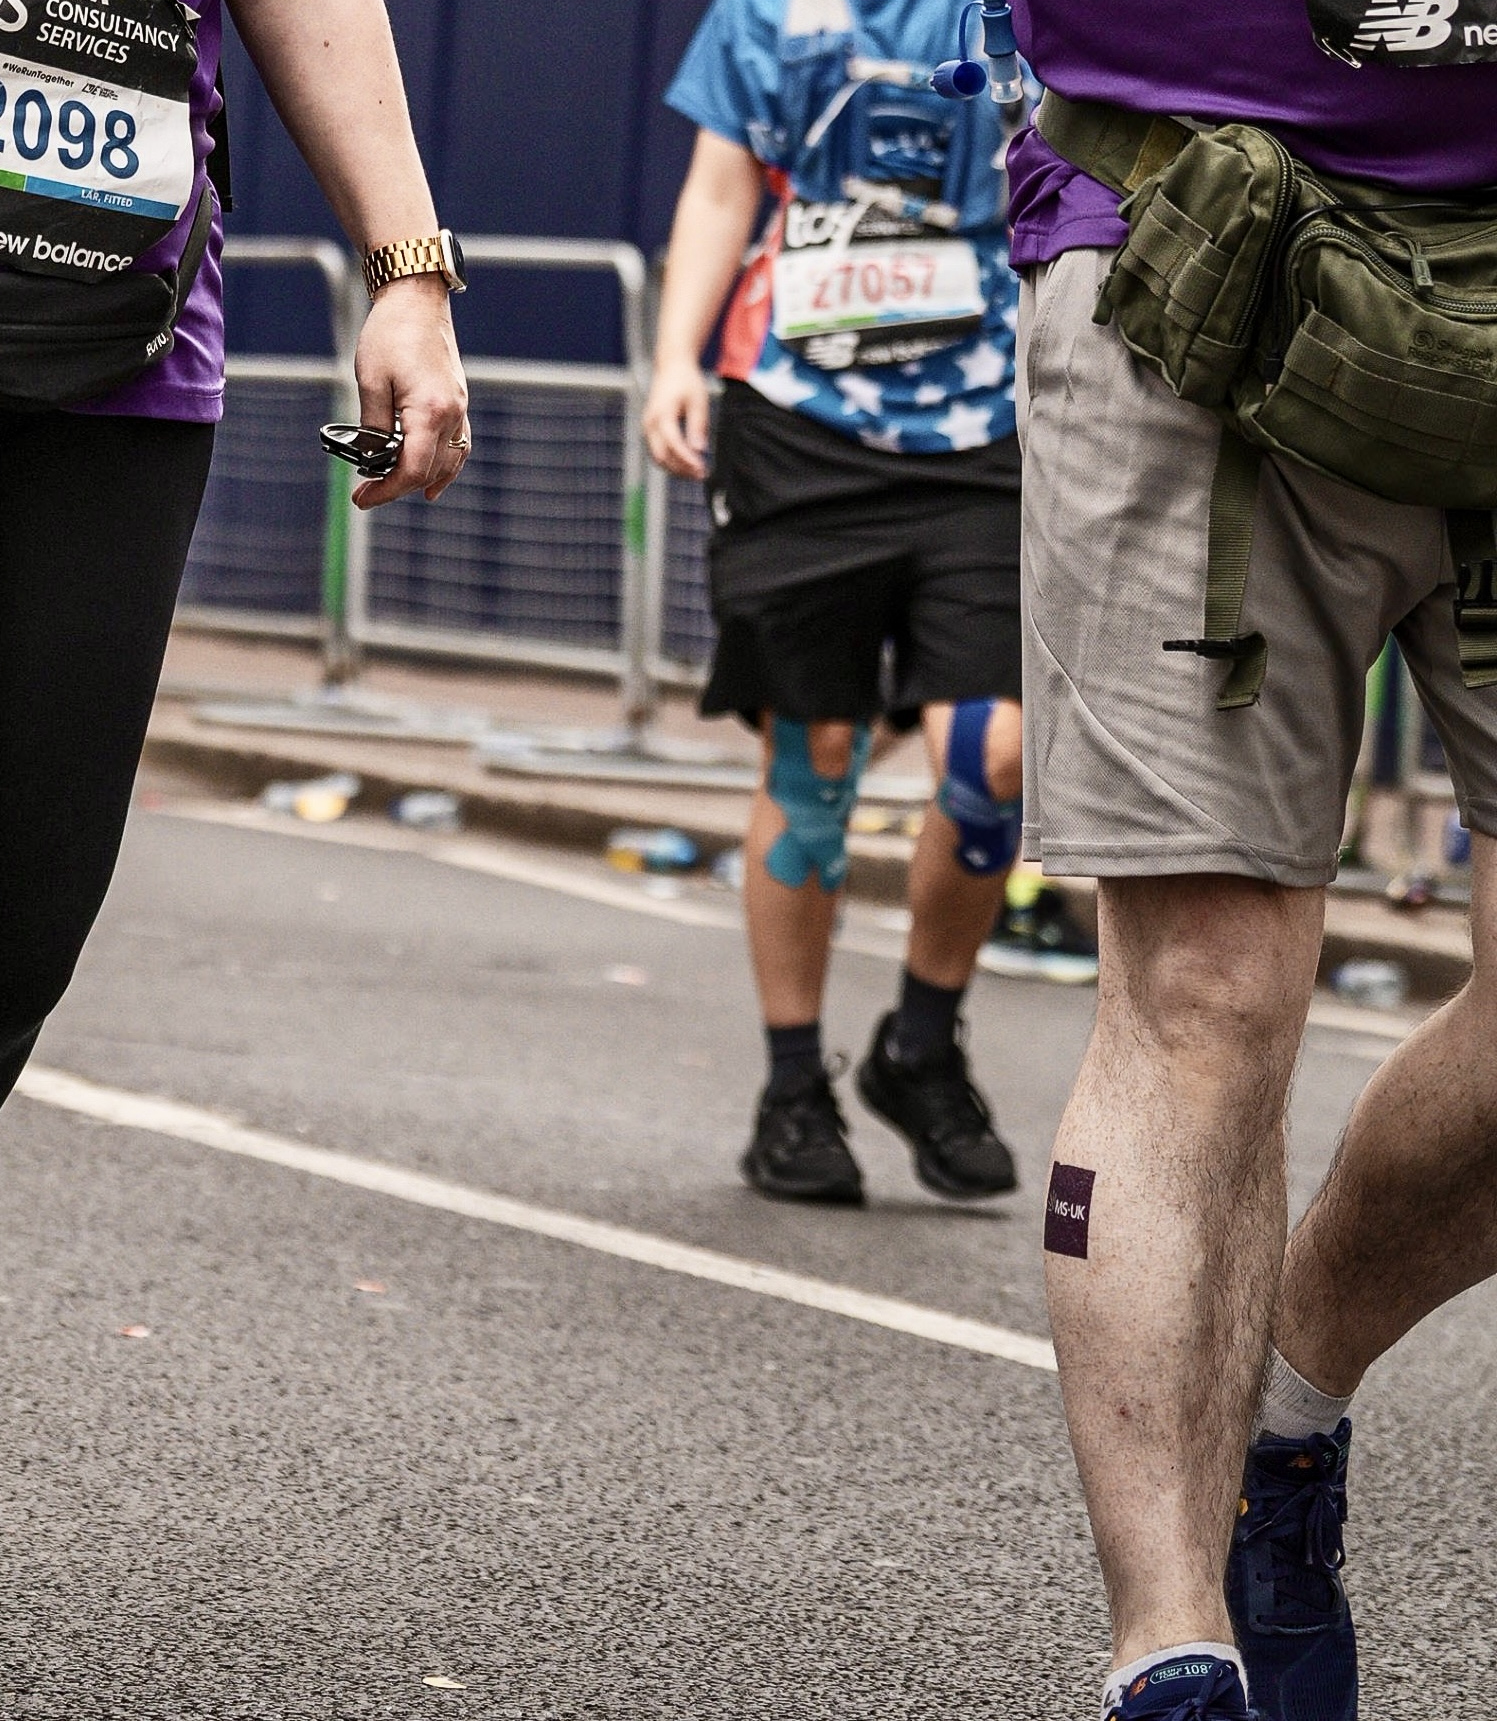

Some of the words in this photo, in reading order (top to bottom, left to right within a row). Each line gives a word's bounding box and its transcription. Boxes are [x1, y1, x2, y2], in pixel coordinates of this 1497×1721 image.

[36, 23, 131, 65] SERVICES
[2, 61, 76, 89] #WeRunTogether
[104, 193, 133, 208] FITTED
[33, 234, 134, 273] balance
[1054, 1198, 1086, 1221] MS-UK
[1184, 1664, 1213, 1675] 108
